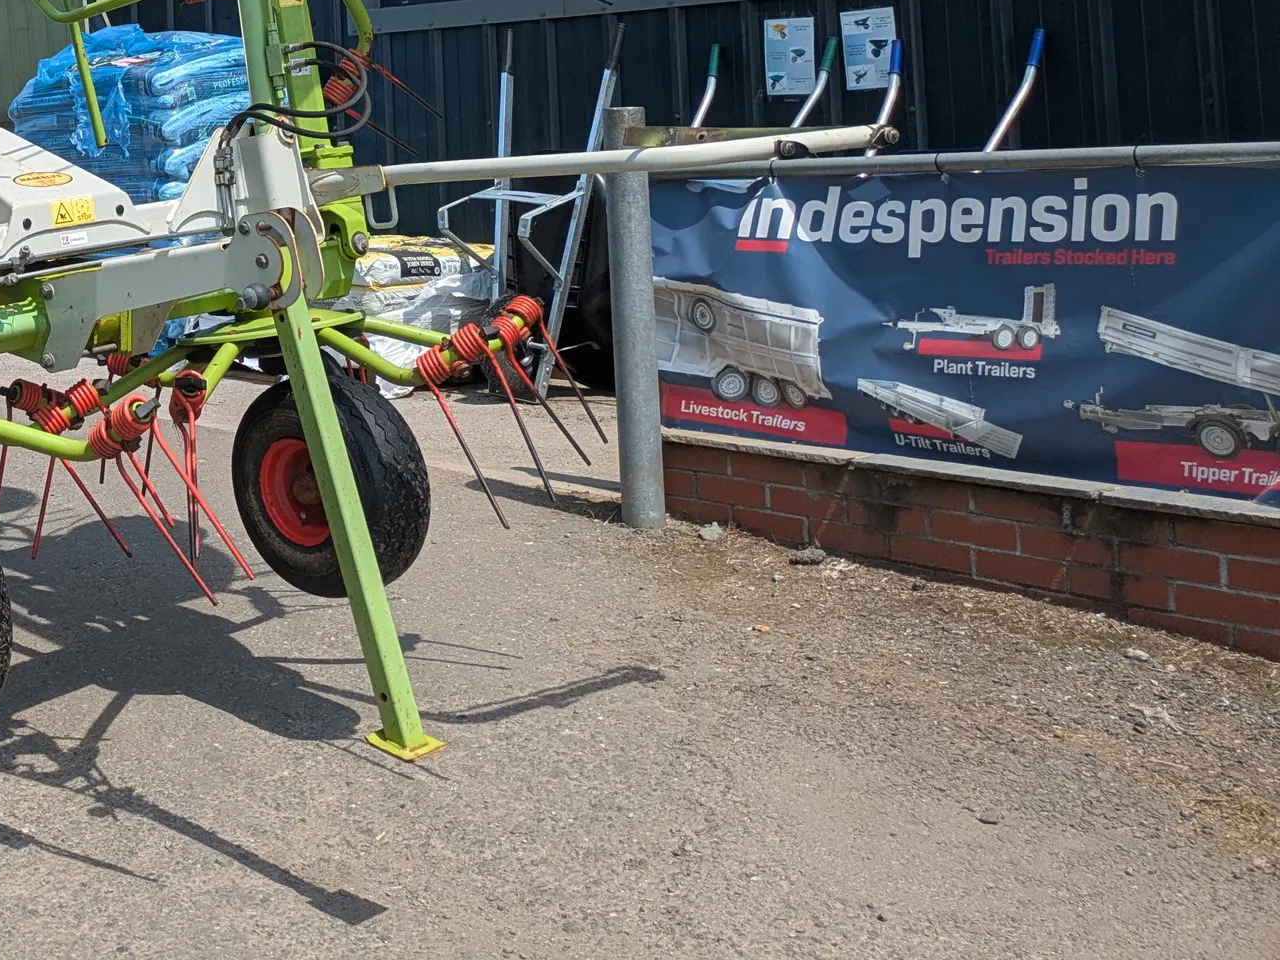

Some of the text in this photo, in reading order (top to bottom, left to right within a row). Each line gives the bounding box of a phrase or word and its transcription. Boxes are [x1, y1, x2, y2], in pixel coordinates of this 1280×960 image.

[737, 177, 1178, 258] indespension
[984, 248, 1176, 266] Trailers Stocked Here
[933, 359, 1036, 379] Plant Trailers
[680, 400, 806, 432] Livestock Trailers
[894, 434, 991, 458] U-Tilt Trailers
[1180, 461, 1239, 484] Tipper
